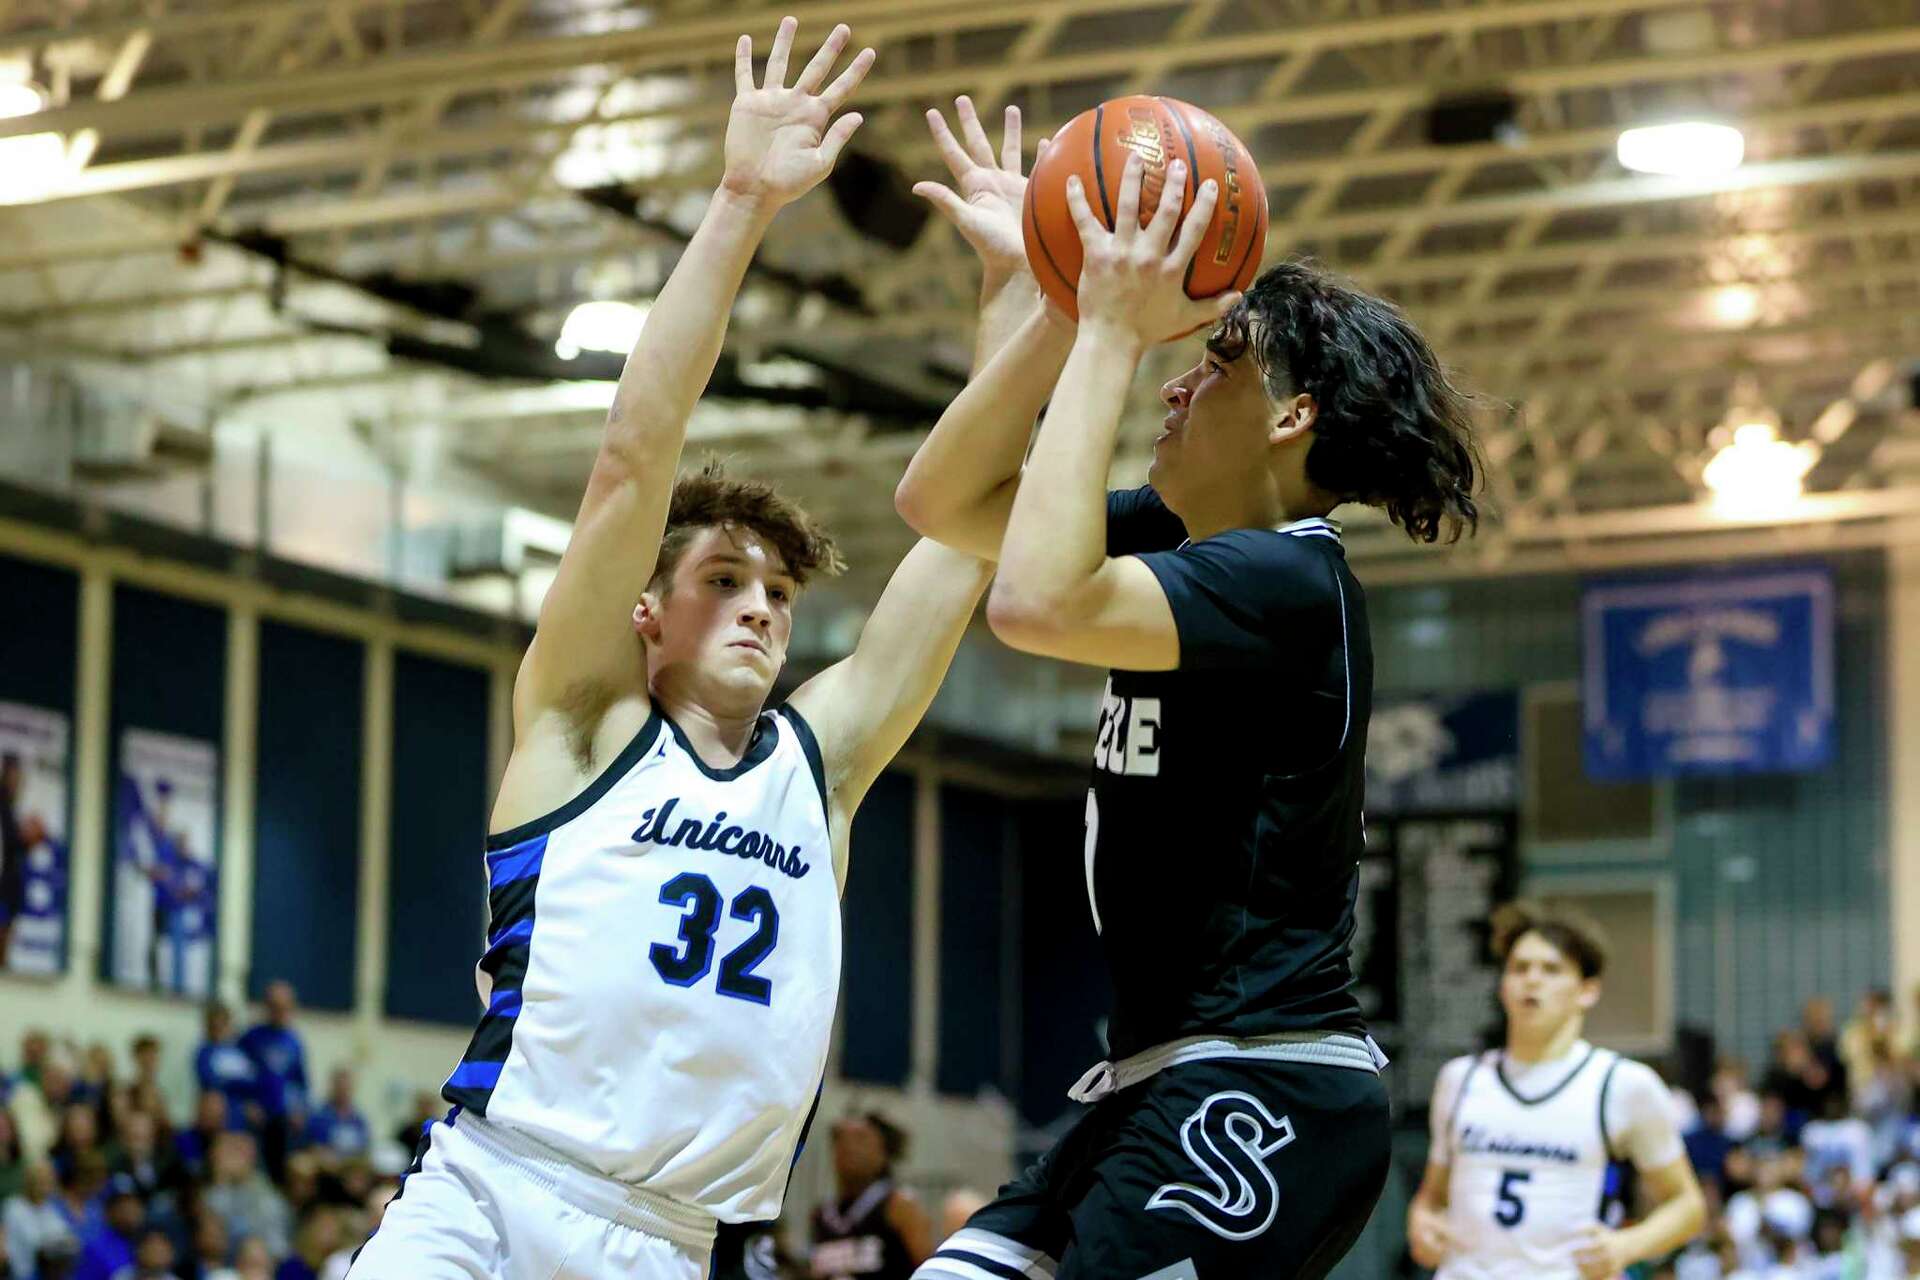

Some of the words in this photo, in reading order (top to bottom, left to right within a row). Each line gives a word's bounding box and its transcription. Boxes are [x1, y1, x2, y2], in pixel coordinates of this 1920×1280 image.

[631, 797, 810, 879] Unicorns
[648, 871, 779, 1007] 32
[1495, 1168, 1530, 1228] 5
